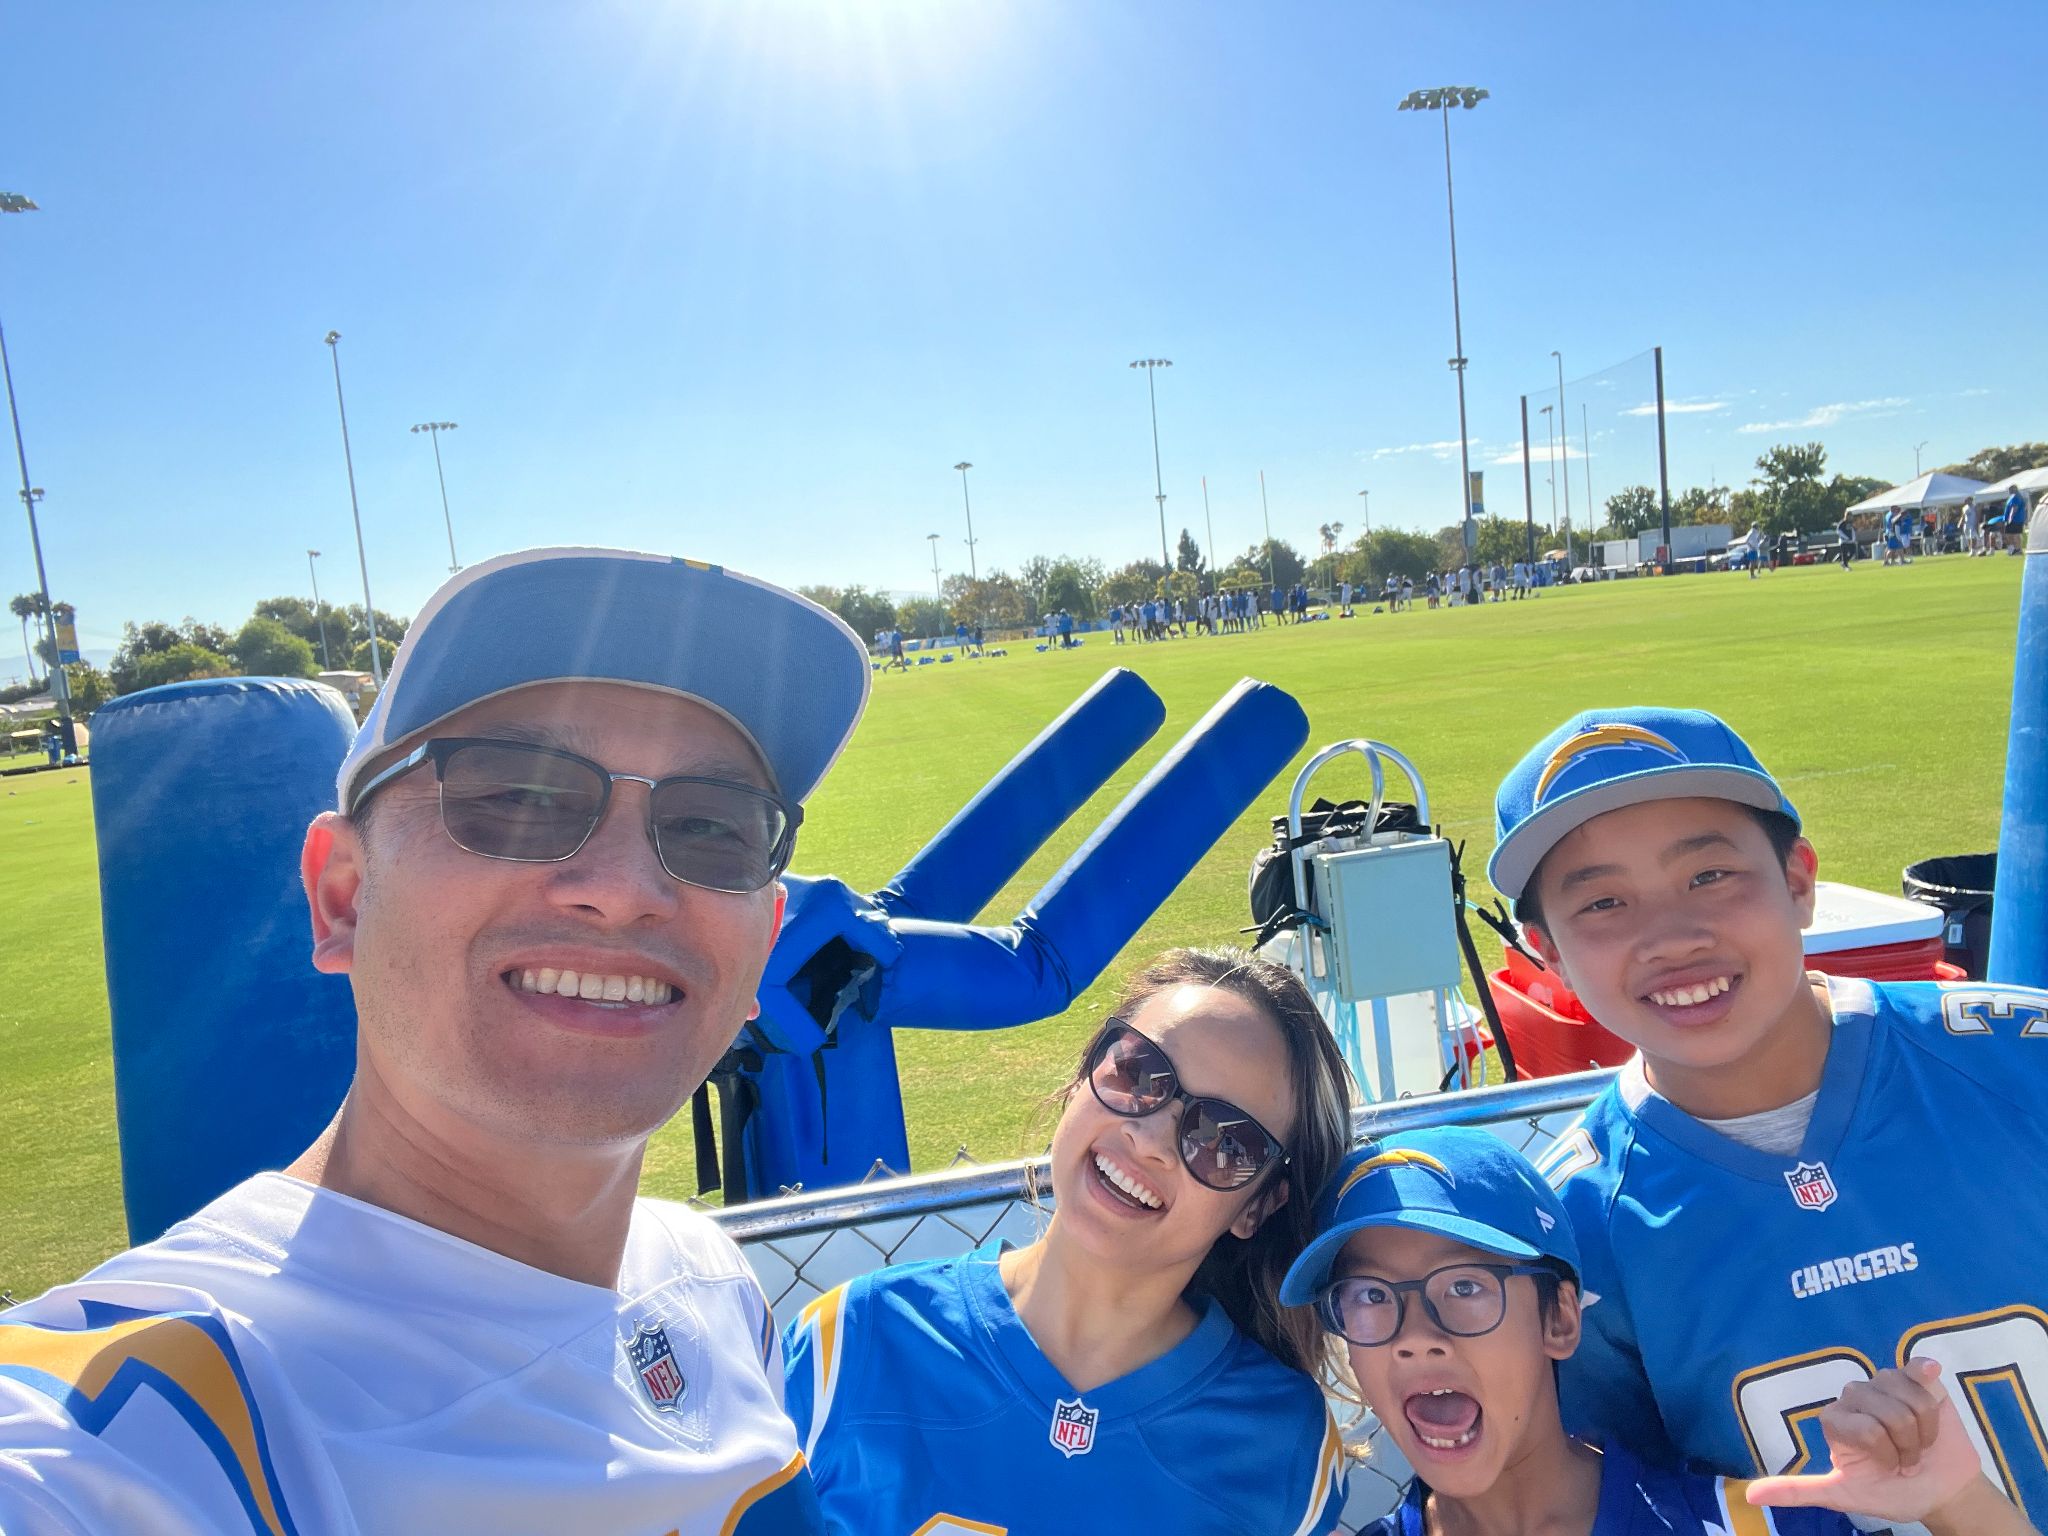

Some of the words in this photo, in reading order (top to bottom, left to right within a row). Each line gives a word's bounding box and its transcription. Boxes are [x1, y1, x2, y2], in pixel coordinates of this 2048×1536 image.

[1797, 1181, 1830, 1204] NFL
[1791, 1241, 1920, 1299] CHARGERS
[642, 1358, 682, 1401] NFL
[1057, 1420, 1087, 1447] NFL
